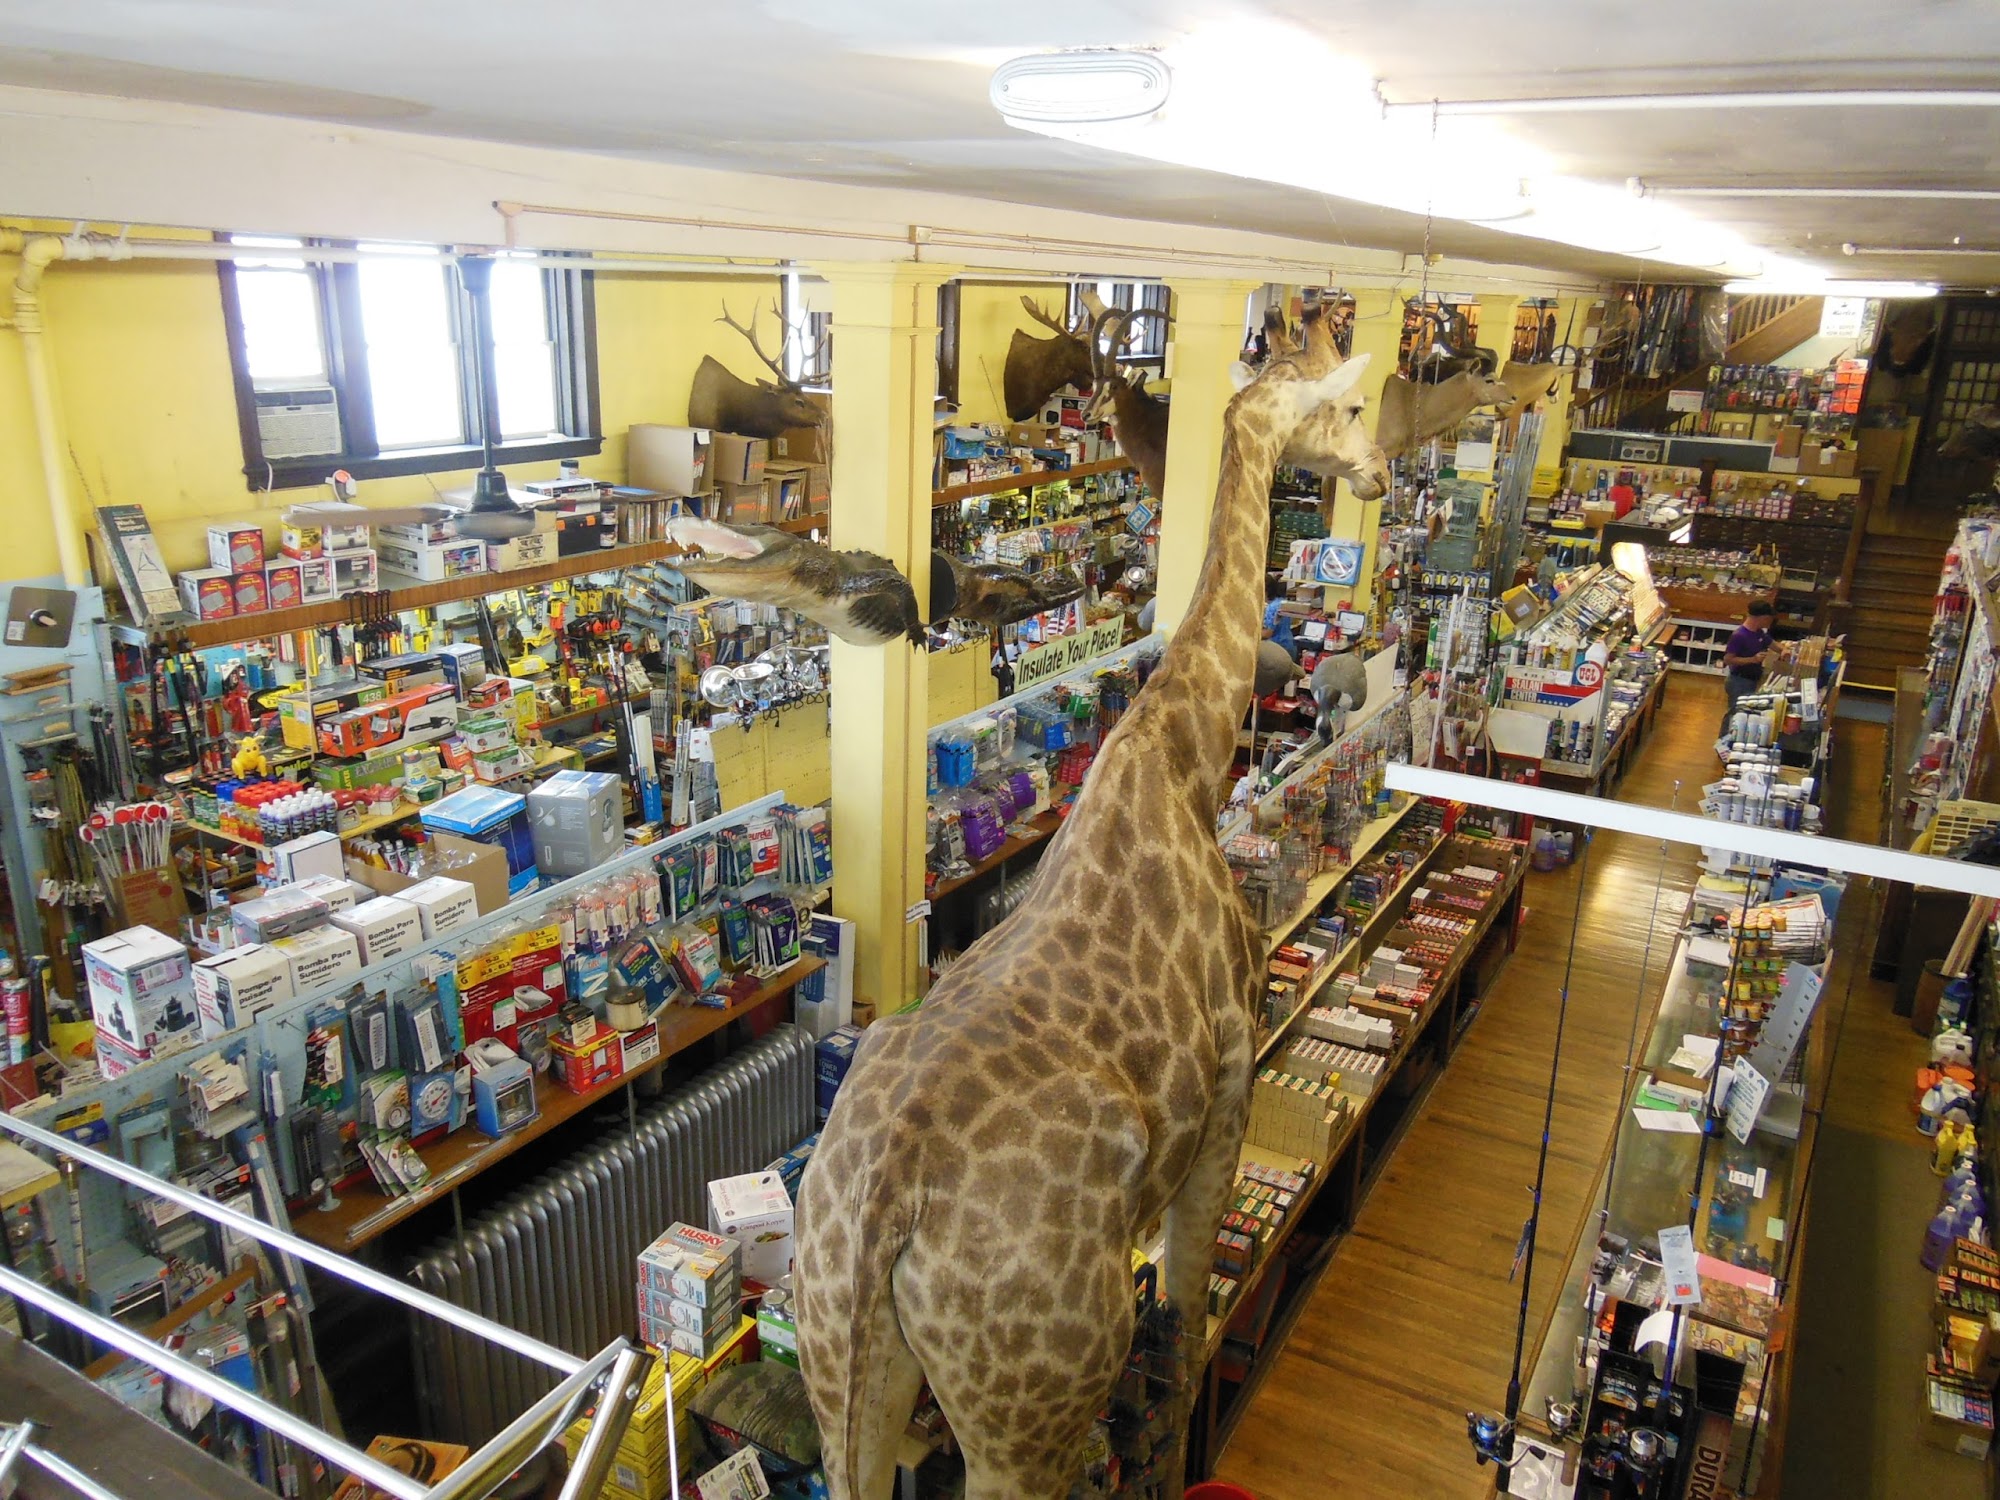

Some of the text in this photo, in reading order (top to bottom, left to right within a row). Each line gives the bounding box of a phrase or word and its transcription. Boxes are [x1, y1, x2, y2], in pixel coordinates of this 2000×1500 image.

[1018, 620, 1120, 685] Insulate Your Place!
[1580, 668, 1596, 682] UGL
[1511, 678, 1544, 692] SEALANT
[363, 691, 382, 703] 438
[1510, 690, 1537, 702] CENTER
[331, 897, 349, 907] Para
[434, 898, 472, 919] Bomba Para
[435, 909, 465, 926] Sumidero
[368, 919, 414, 941] Bomba Para
[369, 930, 405, 948] Sumidero
[298, 949, 352, 972] Bomba Para
[299, 961, 341, 979] Sumidero
[238, 975, 282, 996] Pompe de
[239, 986, 273, 1005] puisard
[460, 992, 470, 1007] 3
[765, 1219, 785, 1227] Keeper
[678, 1227, 725, 1246] HUSKY
[639, 1262, 647, 1286] HUSKY
[640, 1318, 648, 1341] HUSKY
